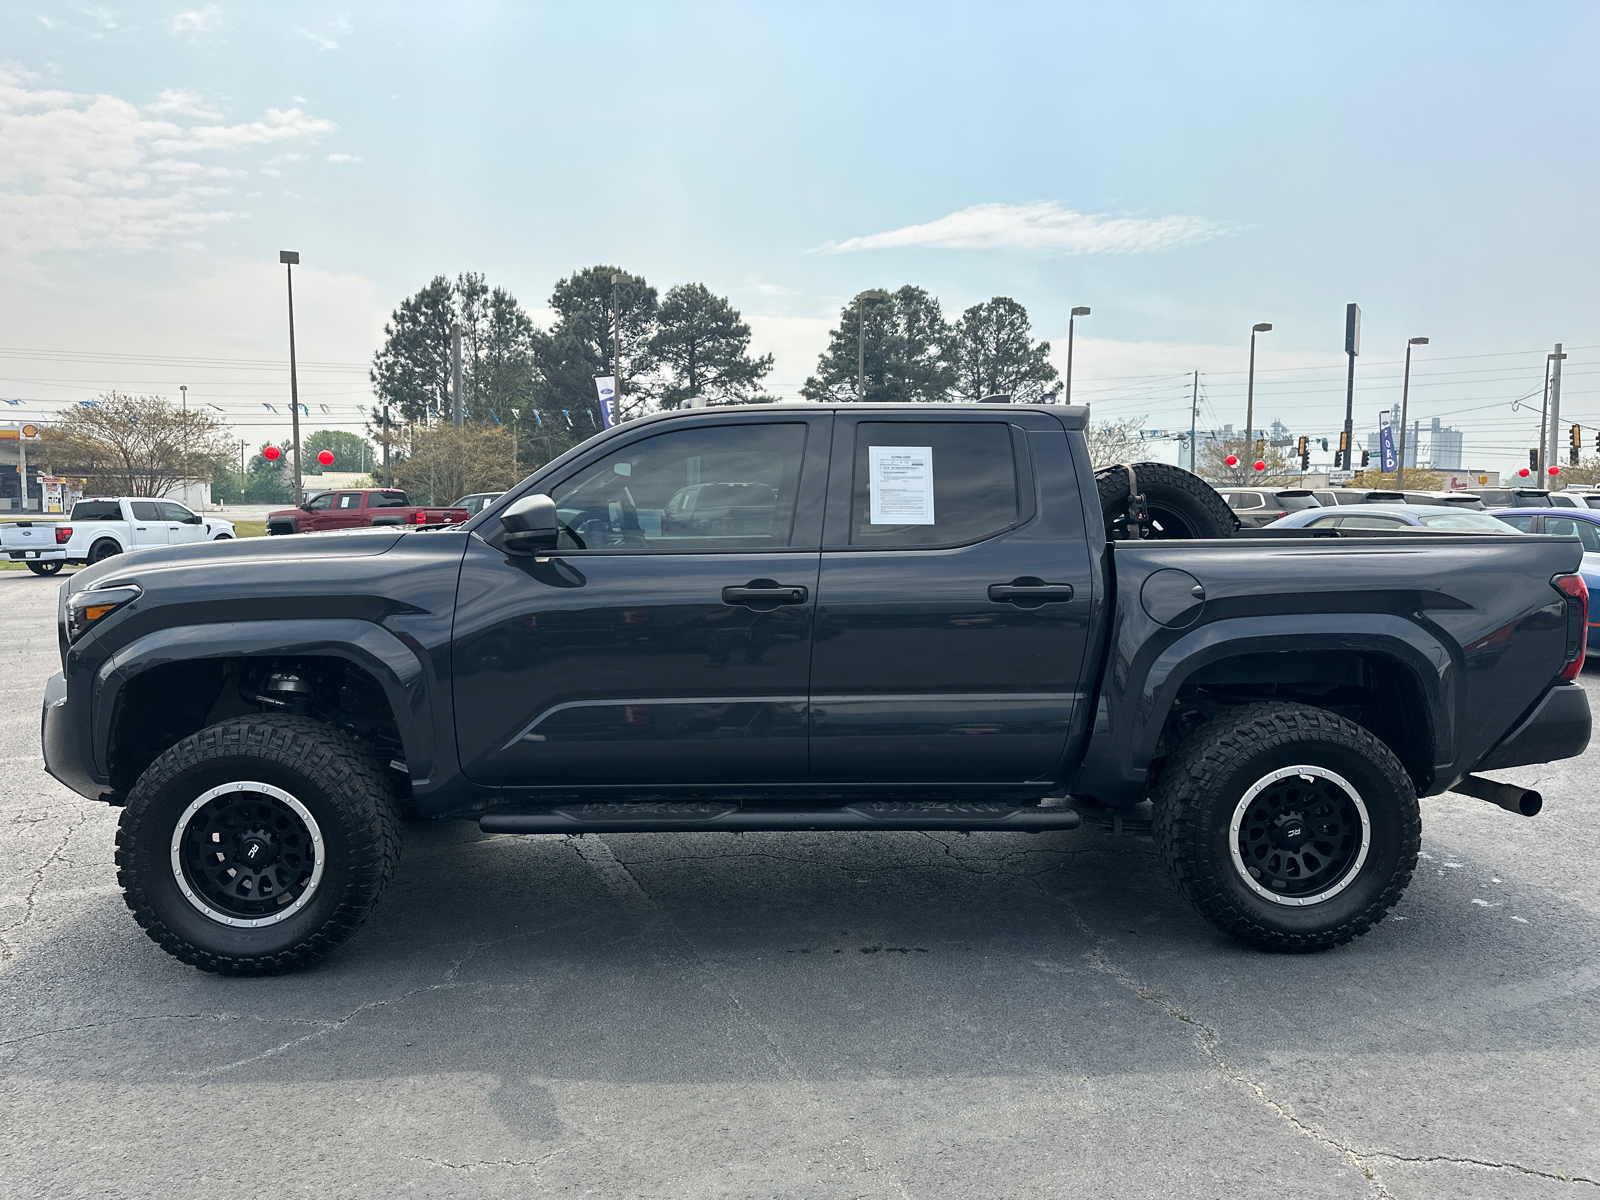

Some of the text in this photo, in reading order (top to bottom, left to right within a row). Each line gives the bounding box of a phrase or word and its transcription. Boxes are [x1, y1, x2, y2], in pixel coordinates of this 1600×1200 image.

[1384, 430, 1395, 468] FORD
[1287, 828, 1301, 837] RC
[247, 843, 259, 859] RC
